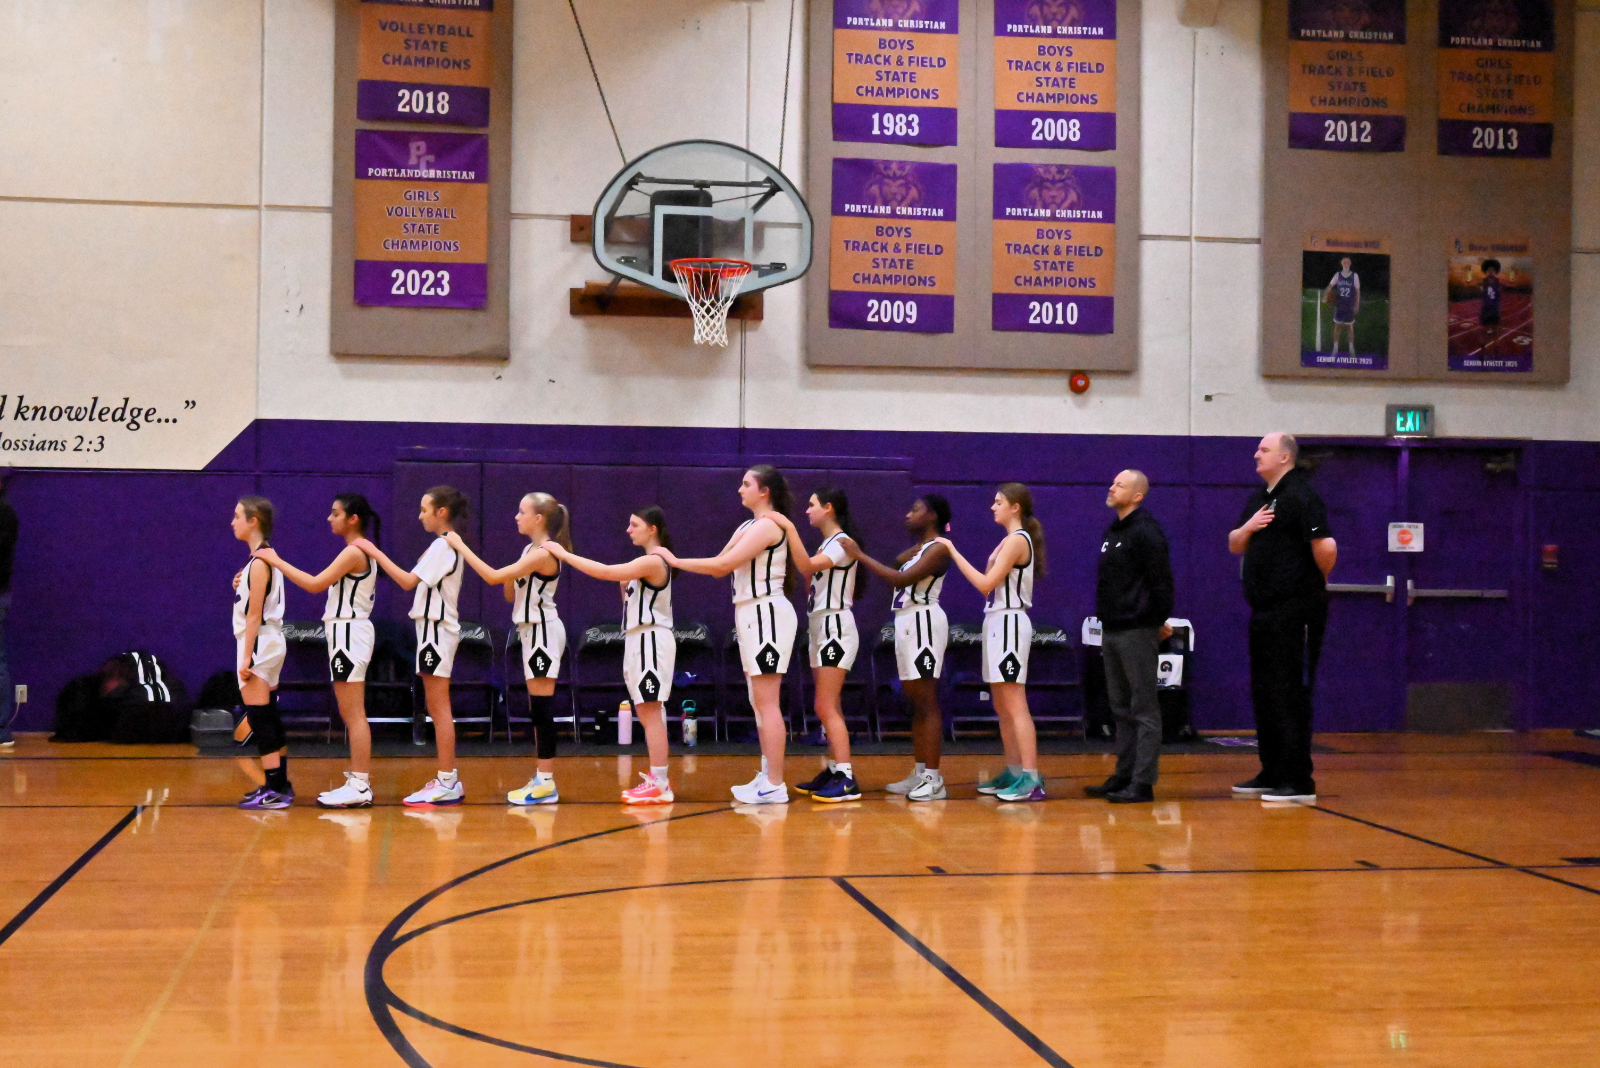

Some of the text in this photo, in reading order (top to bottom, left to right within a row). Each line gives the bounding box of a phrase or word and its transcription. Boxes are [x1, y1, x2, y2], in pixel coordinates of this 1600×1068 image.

[378, 19, 474, 37] VOLLEYBALL
[847, 17, 946, 29] PORTLAND CHRISTIAN
[1007, 24, 1104, 36] PORTLAND CHRISTIAN
[1300, 28, 1394, 40] PORTLAND CHRISTIAN
[403, 38, 448, 52] STATE
[878, 38, 915, 51] BOYS
[1037, 45, 1074, 58] BOYS
[382, 53, 471, 70] CHAMPIONS
[846, 52, 947, 69] TRACK & FIELD
[1327, 50, 1364, 62] GIRLS
[1006, 60, 1105, 74] TRACK & FIELD
[1302, 64, 1343, 76] TRACK
[1358, 66, 1395, 78] FIELD
[1476, 58, 1512, 70] GIRLS
[875, 70, 917, 83] STATE
[1035, 76, 1076, 89] STATE
[1450, 71, 1490, 84] TRACK
[1506, 74, 1542, 86] FIELD
[856, 86, 940, 100] CHAMPIONS
[1328, 80, 1367, 93] STATE
[397, 88, 450, 114] 2018
[1016, 91, 1098, 106] CHAMPIONS
[1476, 88, 1514, 100] STATE
[1309, 95, 1389, 109] CHAMPIONS
[1458, 102, 1537, 116] CHAMPIONS
[872, 112, 920, 137] 1983
[1031, 118, 1081, 142] 2008
[1324, 120, 1372, 143] 2012
[1472, 127, 1518, 150] 2013
[403, 190, 440, 201] GIRLS
[386, 206, 457, 219] VOLLYBALL
[844, 204, 944, 217] PORTLAND CHRISTIAN
[1006, 207, 1103, 219] PORTLAND CHRISTIAN
[403, 223, 440, 235] STATE
[875, 225, 912, 238] BOYS
[1036, 228, 1072, 240] BOYS
[382, 238, 460, 252] CHAMPIONS
[843, 240, 944, 256] TRACK & FIELD
[1004, 242, 1104, 258] TRACK & FIELD
[872, 258, 914, 270] STATE
[1033, 260, 1075, 272] STATE
[391, 269, 450, 296] 2023
[852, 272, 936, 288] CHAMPIONS
[1014, 275, 1097, 289] CHAMPIONS
[866, 299, 918, 324] 2009
[1028, 302, 1079, 326] 2010
[0, 432, 105, 452] ossians 2:3
[586, 628, 627, 644] Royal
[673, 628, 706, 642] oyals
